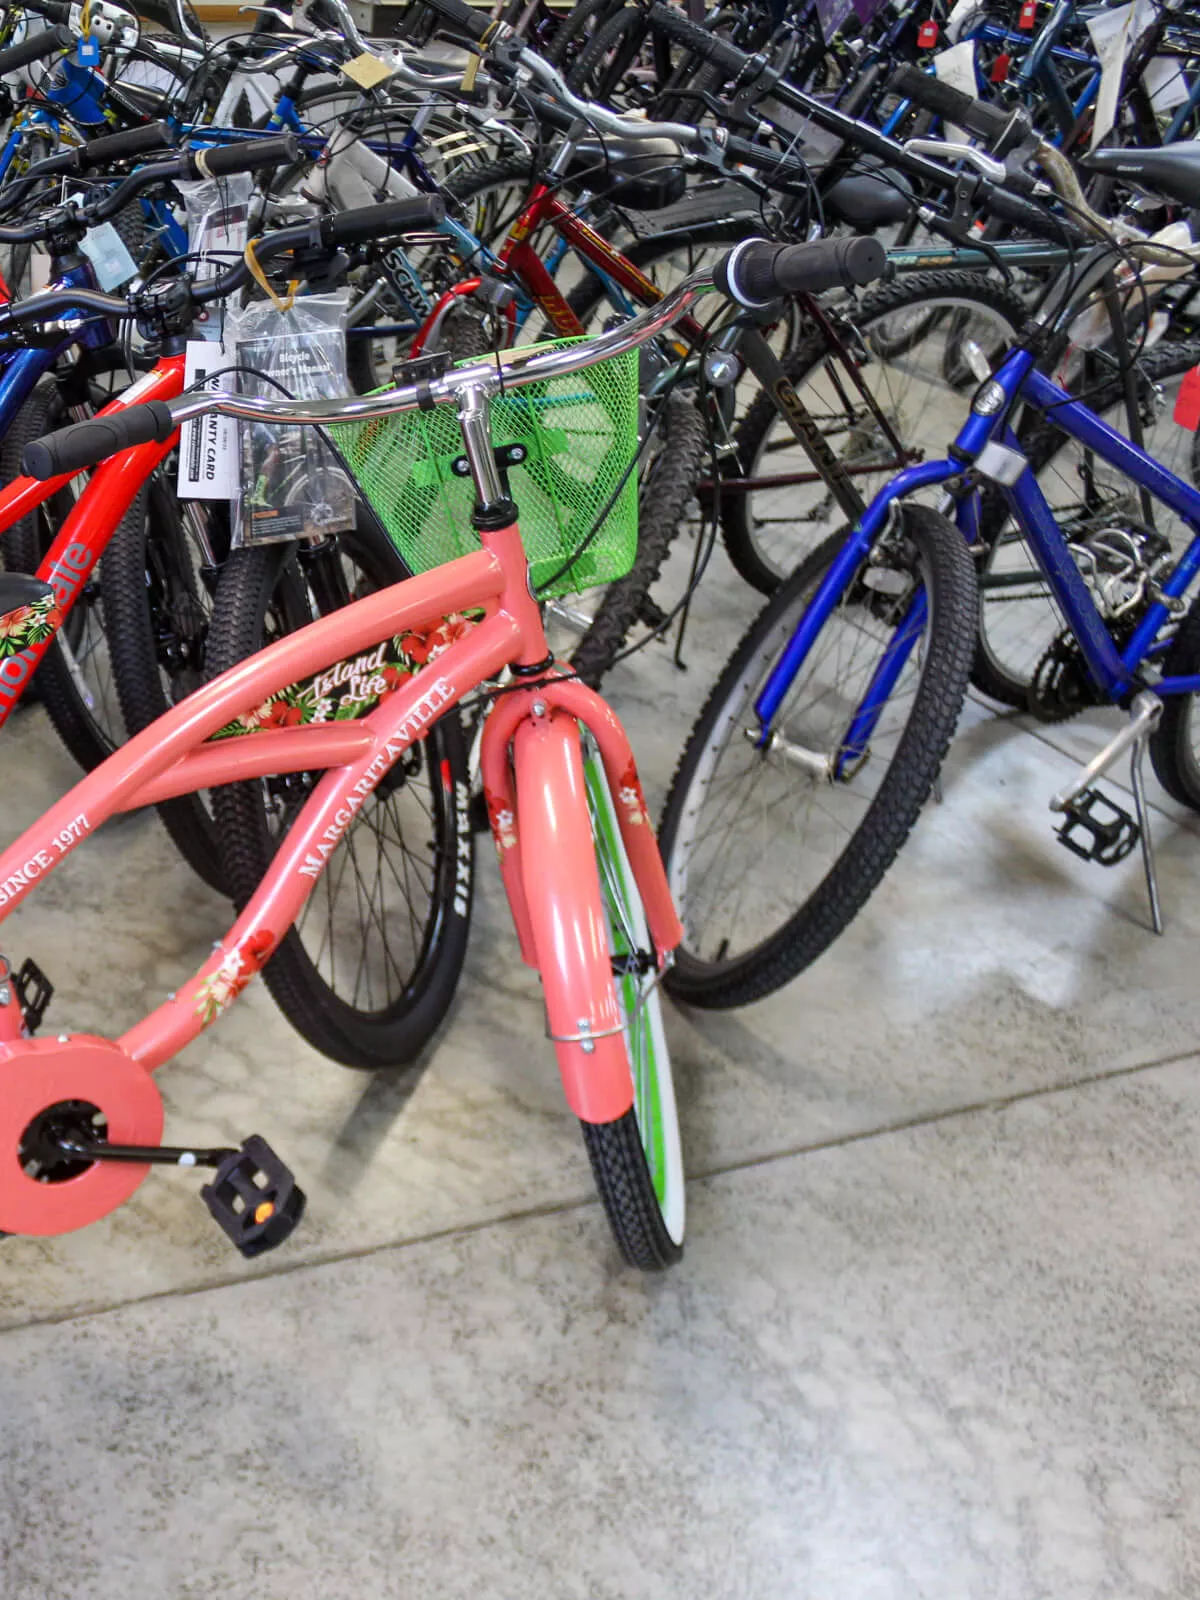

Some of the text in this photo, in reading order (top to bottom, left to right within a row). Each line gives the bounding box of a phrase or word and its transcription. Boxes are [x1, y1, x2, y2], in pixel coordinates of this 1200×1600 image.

[383, 249, 431, 318] SCHW
[206, 449, 216, 480] CARD
[296, 642, 388, 706] Island
[340, 674, 388, 707] Life
[298, 676, 457, 880] MARGARITAVILLE
[51, 813, 90, 853] 1977
[454, 780, 471, 918] MAXXIS
